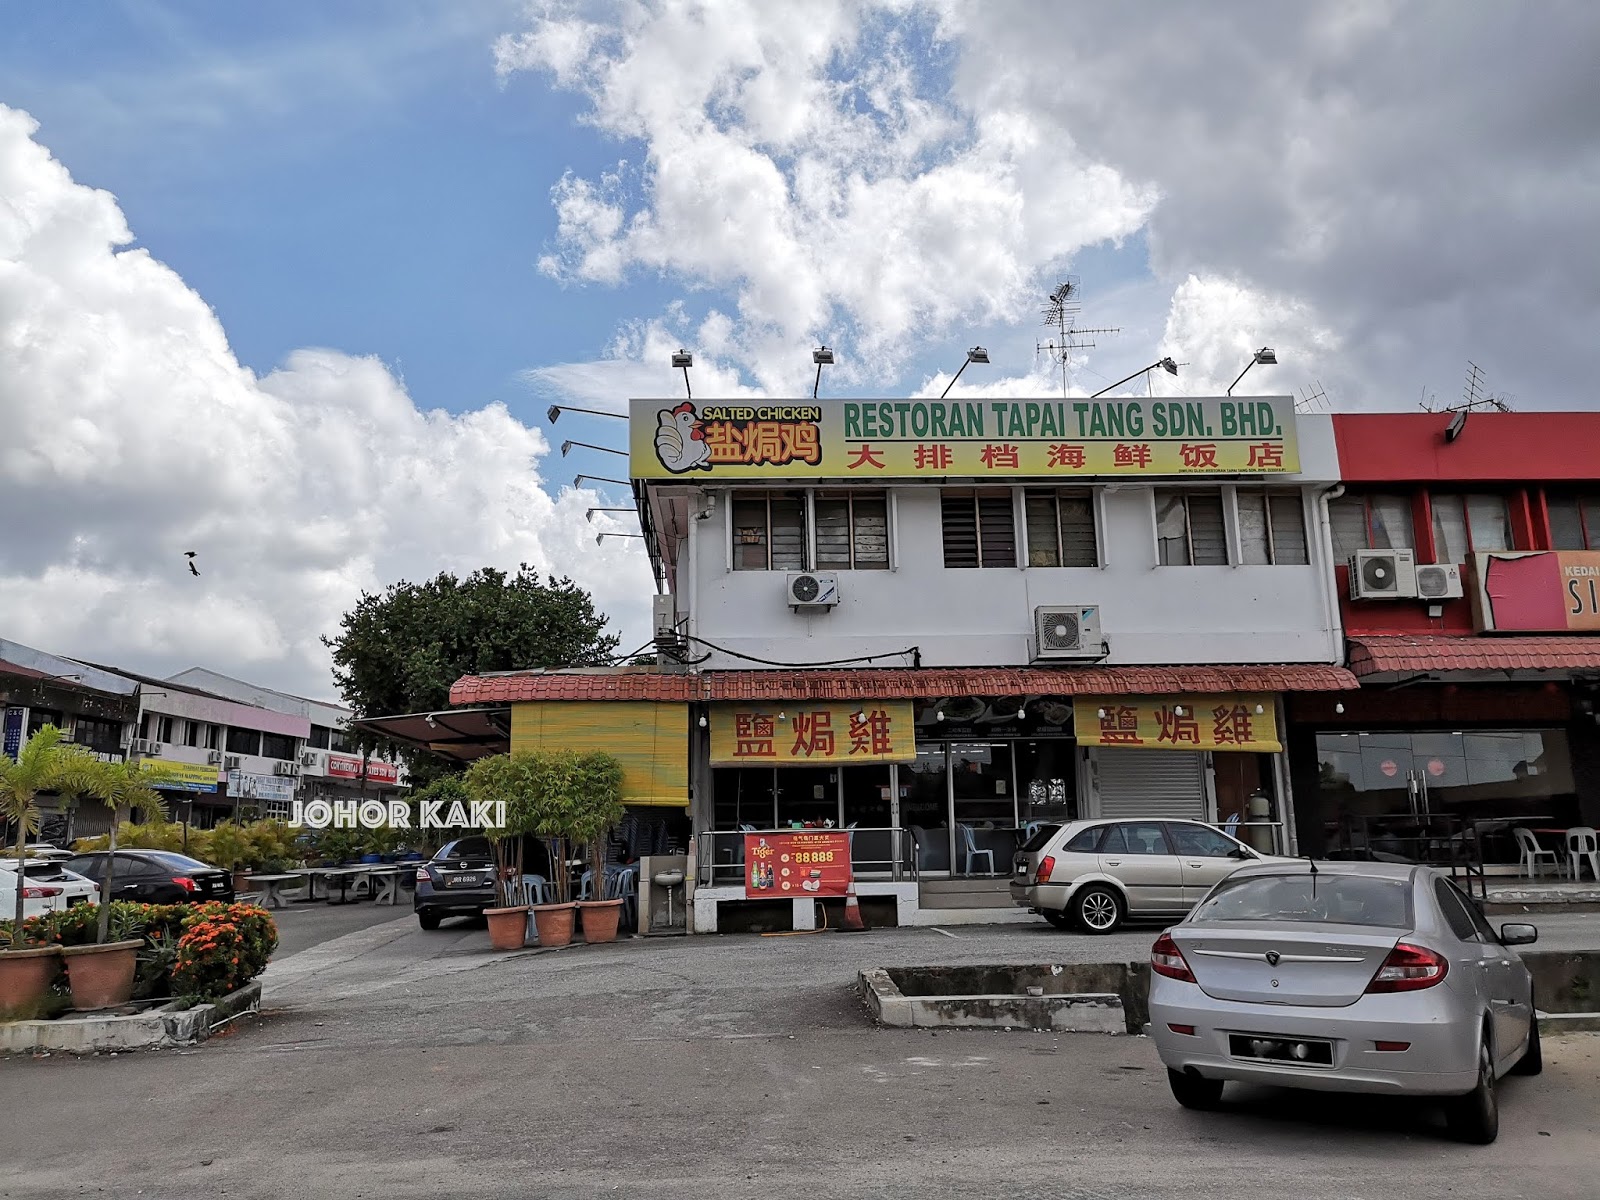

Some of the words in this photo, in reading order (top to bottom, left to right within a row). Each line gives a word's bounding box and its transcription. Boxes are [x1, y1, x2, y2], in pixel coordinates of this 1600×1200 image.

[703, 407, 754, 420] SALTED
[757, 407, 819, 420] CHICKEN
[844, 402, 984, 437] RESTORAN
[992, 402, 1066, 437] TAPAI
[1073, 402, 1144, 437] TANG
[1152, 402, 1212, 437] SDN.
[1220, 402, 1282, 436] BHD.
[704, 421, 820, 463] 盐焗鸡
[847, 442, 1283, 470] 大排档海鲜饭店
[733, 710, 893, 757] 鹽焗雞
[1099, 704, 1257, 745] 鹽焗雞
[330, 760, 358, 773] CONTINENTAL
[751, 846, 775, 859] Tiger
[795, 851, 834, 864] 88,888
